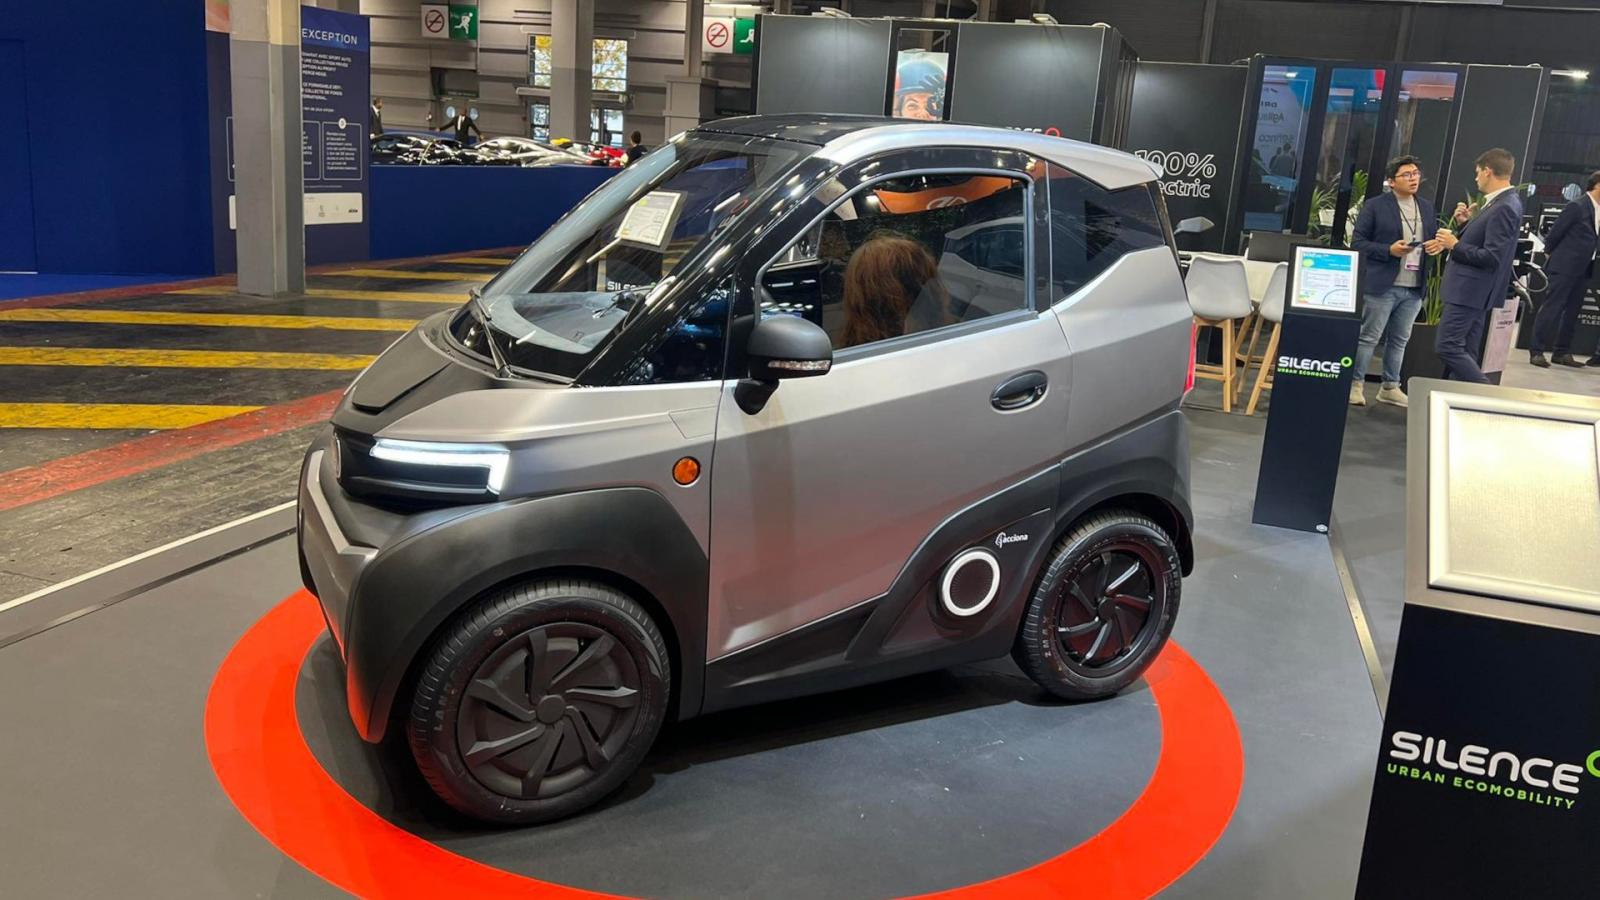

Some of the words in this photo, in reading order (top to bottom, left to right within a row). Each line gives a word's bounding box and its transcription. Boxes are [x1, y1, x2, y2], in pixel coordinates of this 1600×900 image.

[1278, 356, 1341, 374] SILENCE
[1299, 370, 1339, 379] ECOMOBILITY
[1002, 534, 1028, 544] acciona
[1390, 731, 1584, 794] SILENCE
[1387, 763, 1445, 784] URBAN
[1453, 777, 1576, 809] ECOMOBILITY
